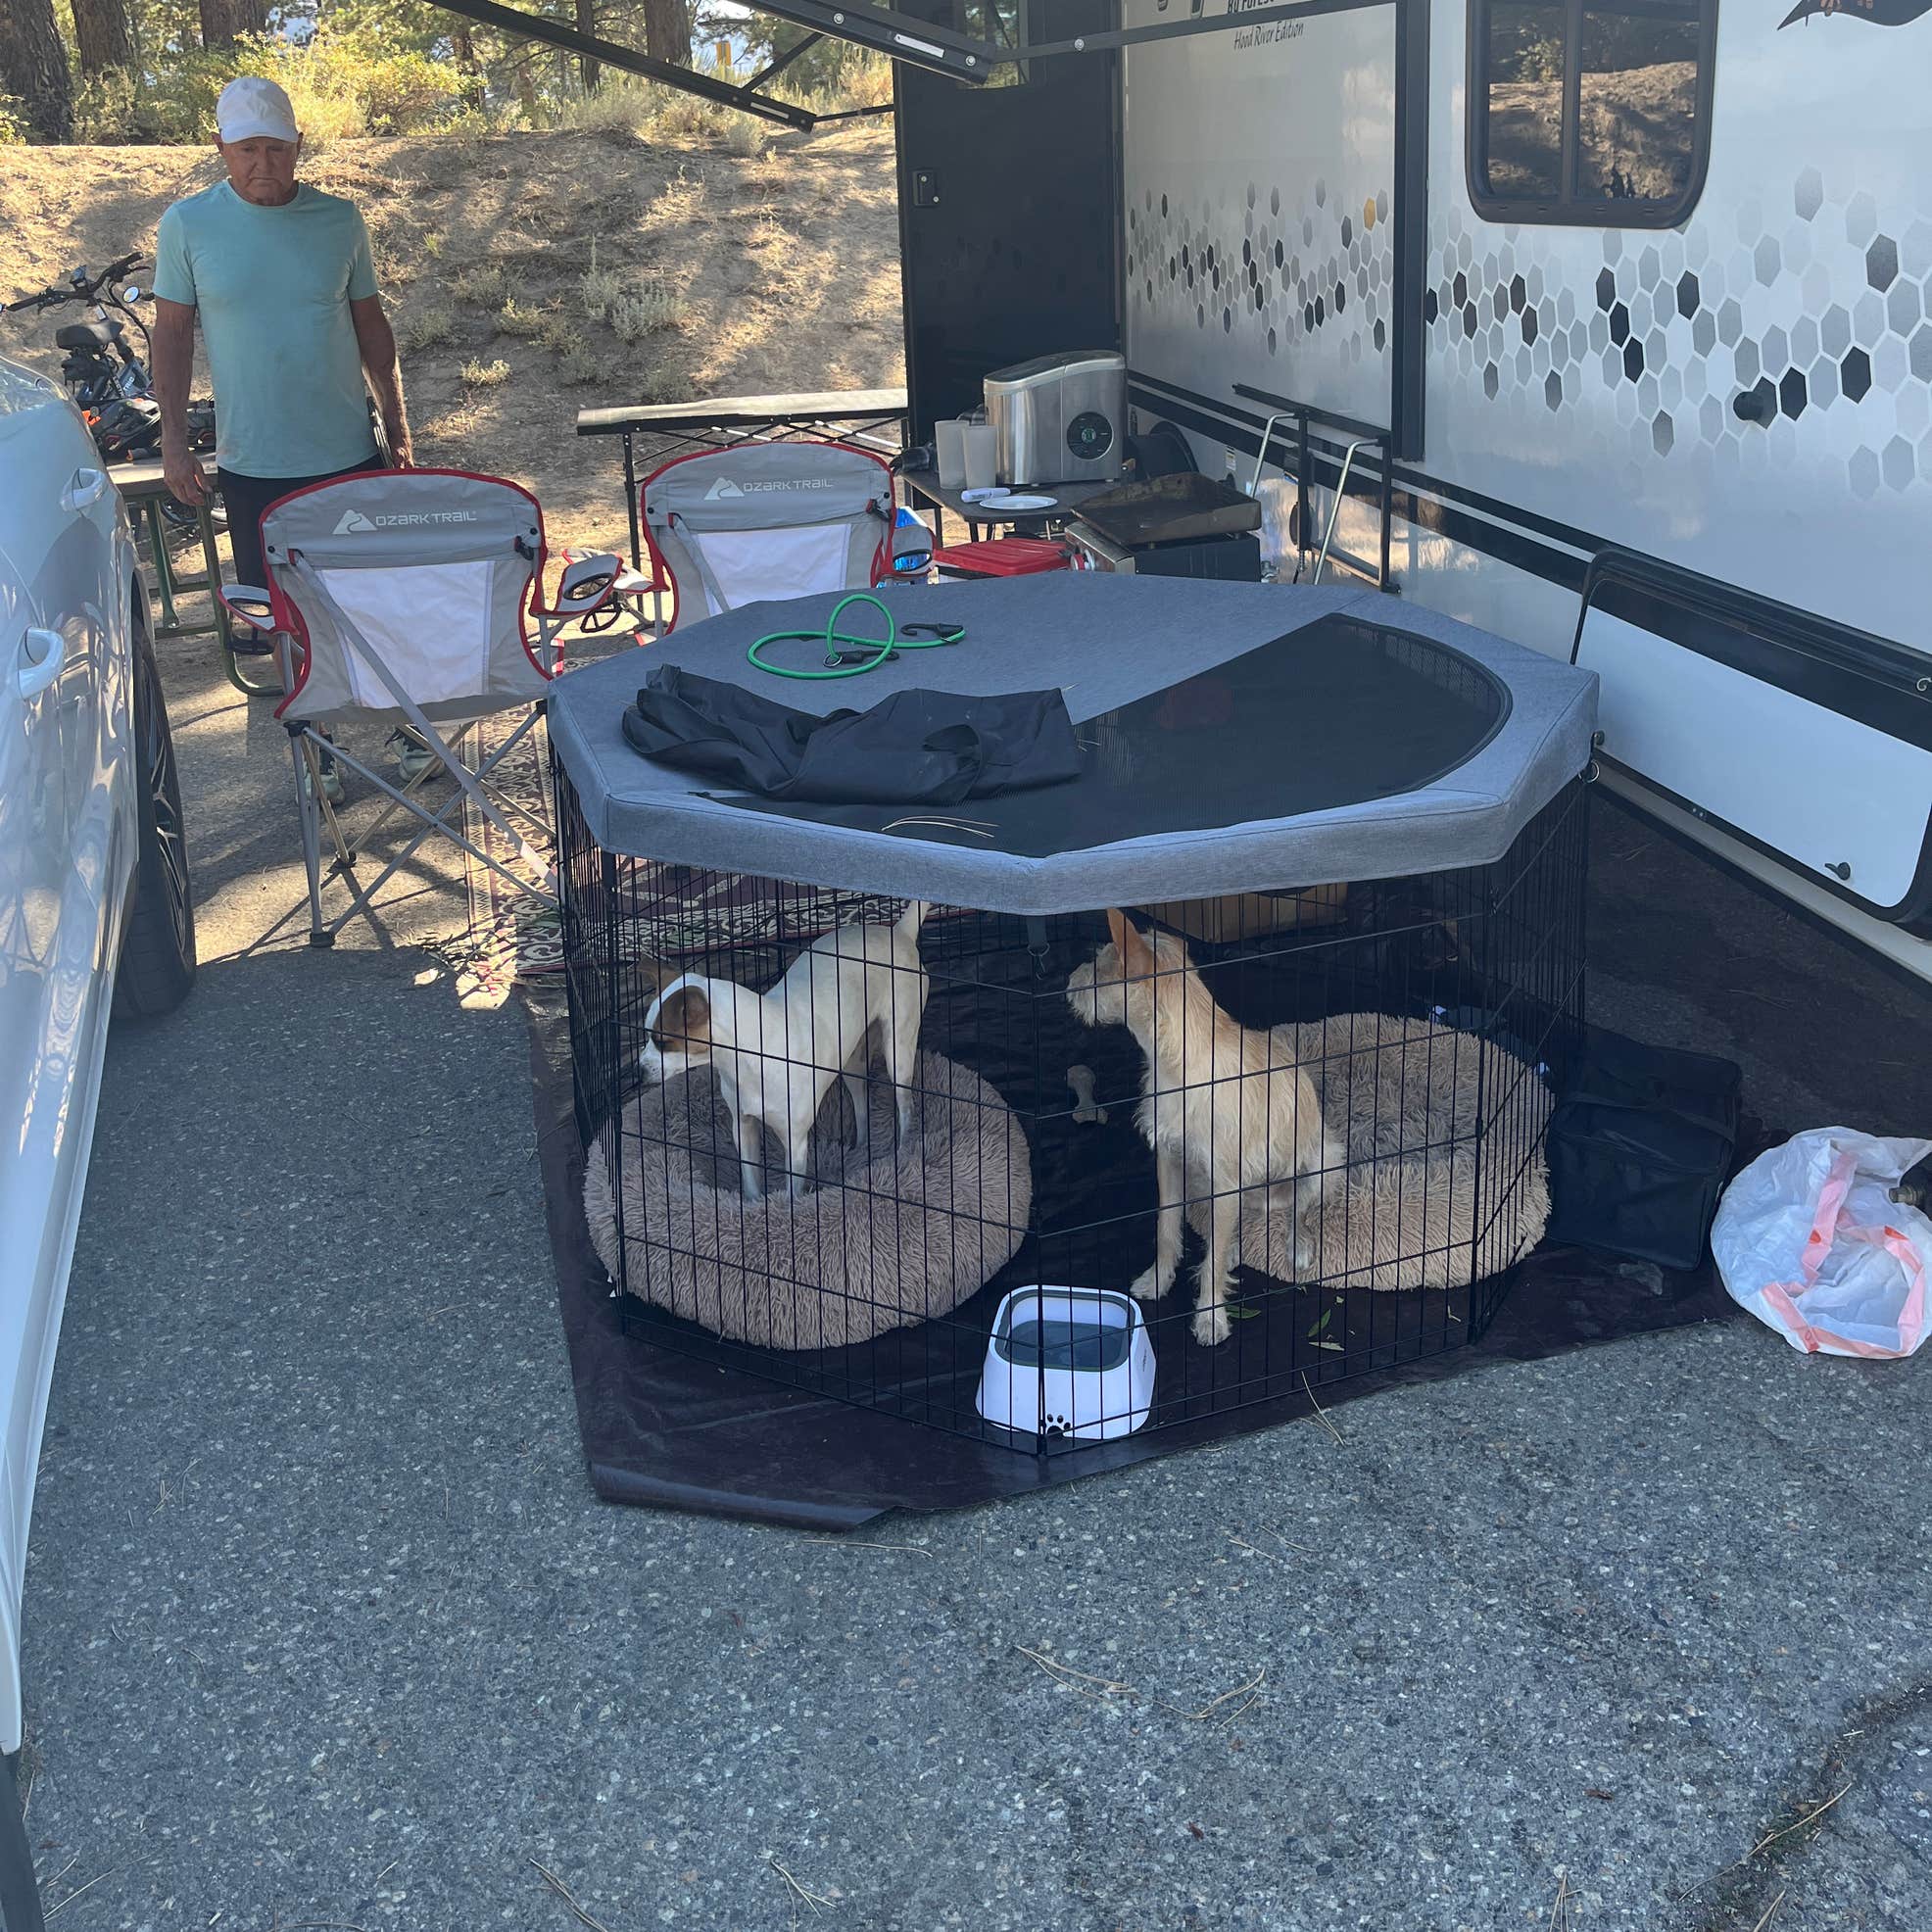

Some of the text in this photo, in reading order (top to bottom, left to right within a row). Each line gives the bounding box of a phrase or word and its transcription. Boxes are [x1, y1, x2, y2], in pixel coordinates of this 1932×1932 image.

[1233, 19, 1304, 50] Hood River Edition
[744, 478, 834, 492] OZARK TRAIL
[375, 510, 478, 526] OZARK TRAIL
